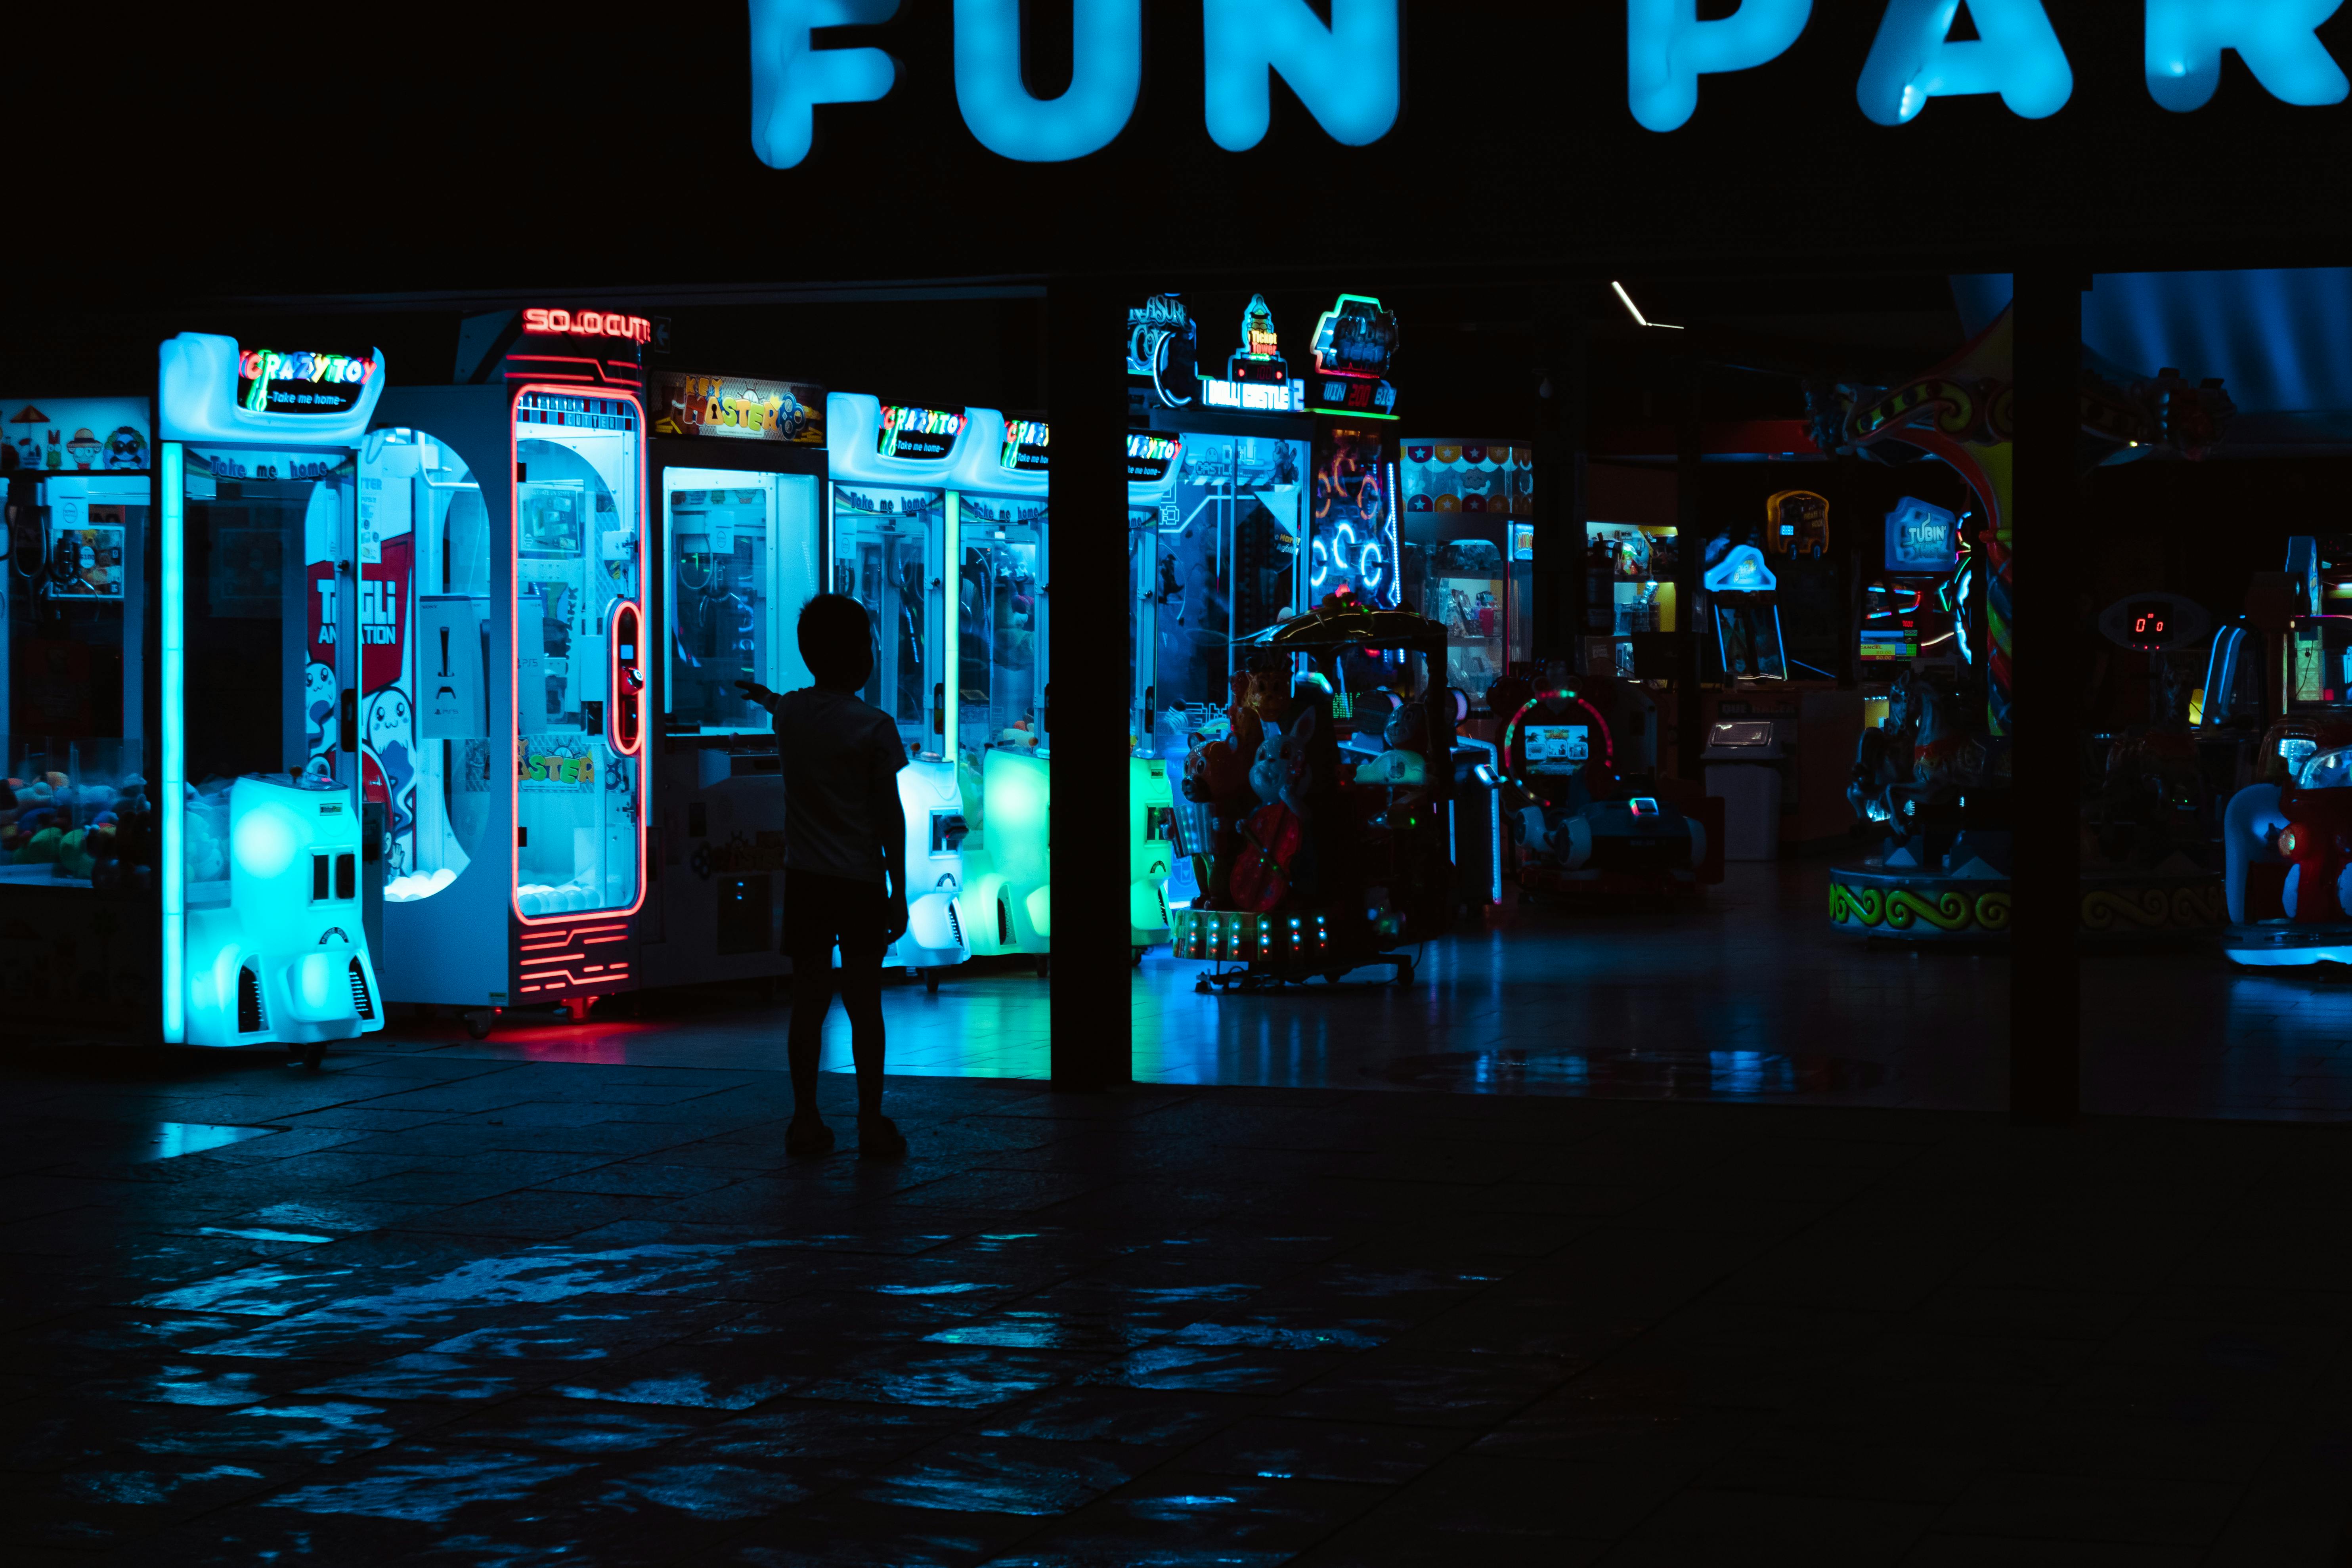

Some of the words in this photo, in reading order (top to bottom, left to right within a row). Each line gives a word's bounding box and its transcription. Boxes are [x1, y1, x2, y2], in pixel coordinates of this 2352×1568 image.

[748, 0, 1401, 169] FUN
[524, 308, 602, 335] SOLO
[1251, 330, 1277, 344] Ticket
[1252, 342, 1277, 355] Tower
[685, 375, 723, 398] KEY
[1323, 382, 1346, 401] WIN
[298, 394, 312, 404] me
[684, 394, 778, 432] MASTER
[913, 443, 923, 451] me
[210, 455, 247, 480] Take
[257, 465, 278, 480] me
[289, 460, 329, 480] home
[1017, 453, 1031, 463] Take
[851, 491, 874, 512] Take
[880, 499, 894, 513] me
[901, 496, 926, 513] home
[974, 502, 994, 520] Take
[999, 509, 1010, 522] me
[1017, 506, 1039, 521] home
[2136, 618, 2146, 632] 0
[2156, 621, 2163, 631] 0
[522, 659, 538, 667] PS5
[518, 753, 595, 784] ASTER
